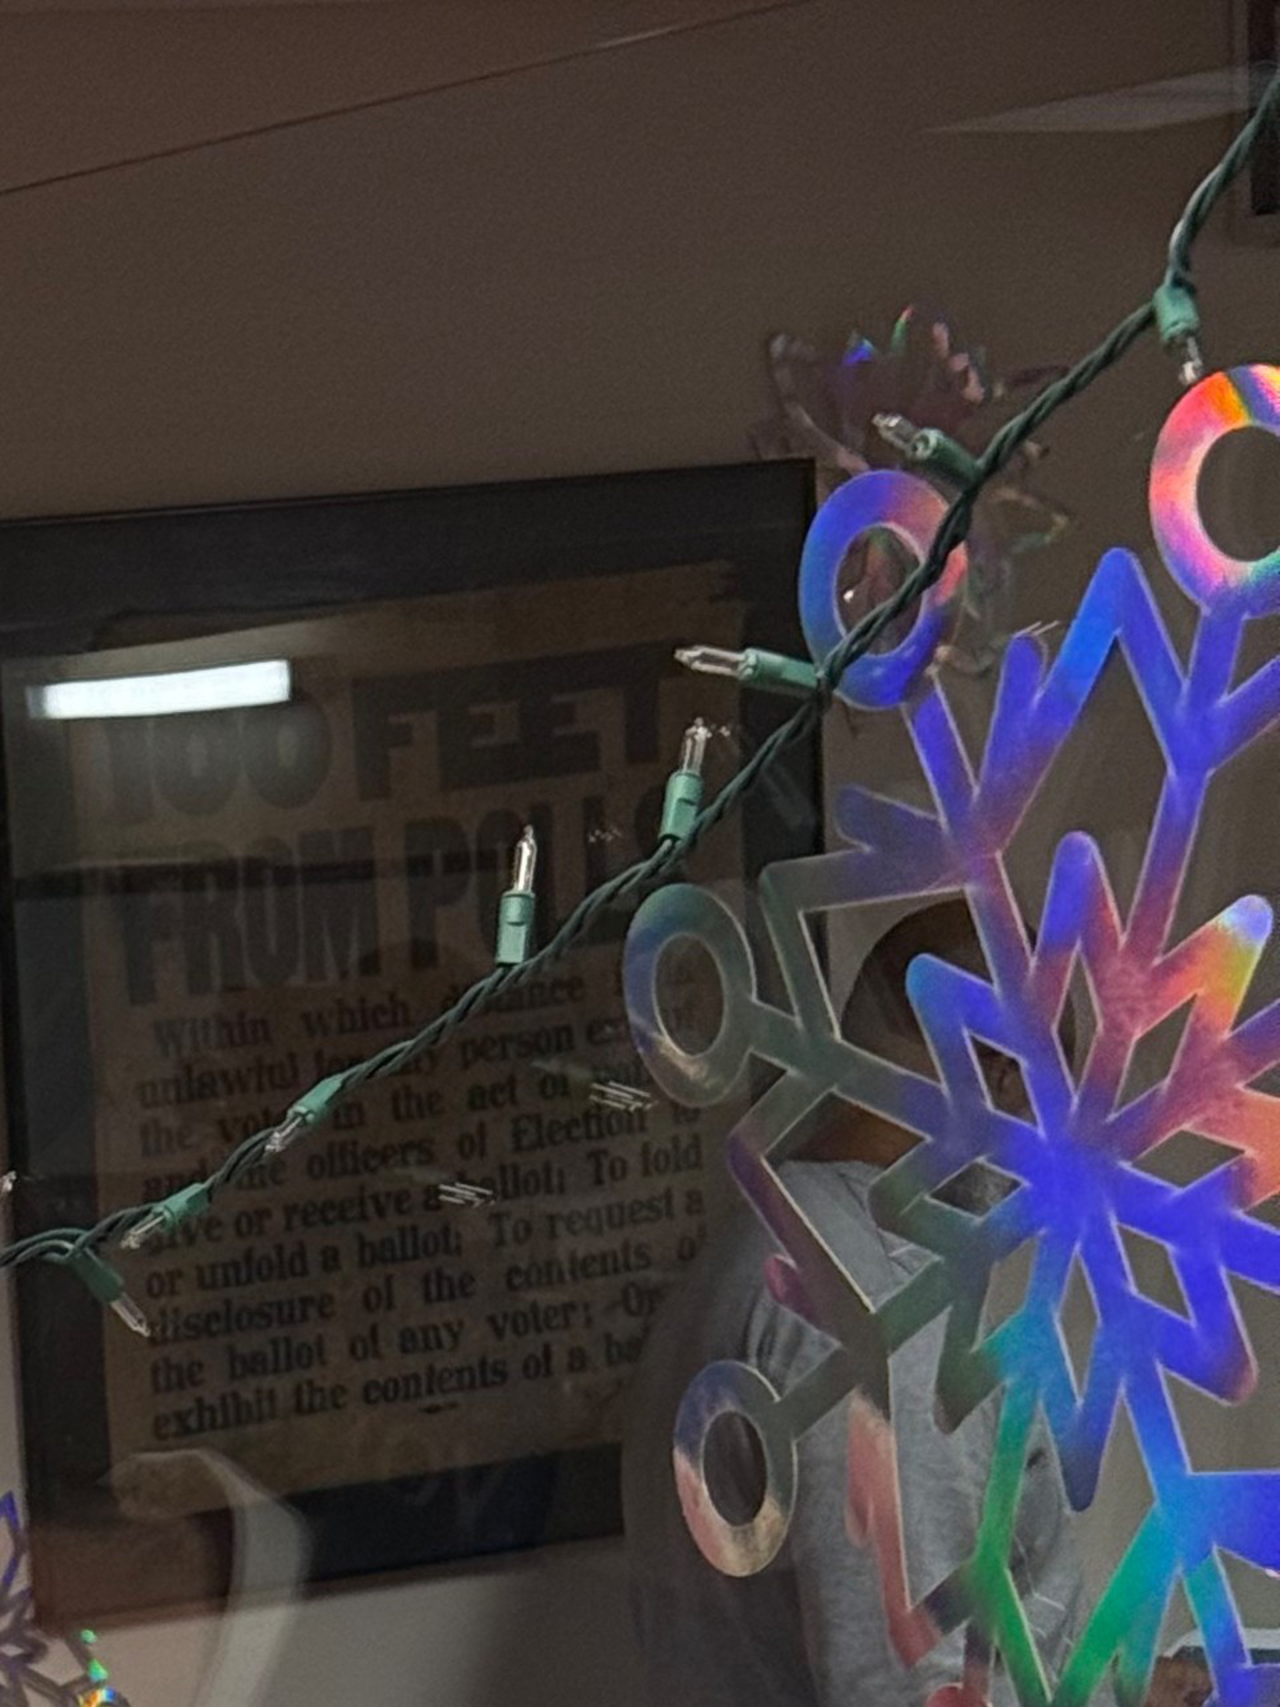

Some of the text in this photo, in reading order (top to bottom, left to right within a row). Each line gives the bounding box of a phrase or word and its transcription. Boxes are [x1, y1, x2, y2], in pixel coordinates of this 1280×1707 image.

[351, 642, 662, 802] FEET
[104, 827, 382, 1006] FROM
[137, 1052, 298, 1106] unlawful
[460, 1024, 574, 1069] person
[153, 1008, 272, 1057] Within
[301, 992, 411, 1037] which
[139, 1116, 192, 1156] the
[391, 1084, 444, 1121] the
[466, 1073, 518, 1110] act
[306, 1136, 435, 1180] officers
[456, 1119, 488, 1160] of
[510, 1106, 647, 1151] Election
[235, 1208, 273, 1238] or
[284, 1186, 411, 1231] receive
[587, 1150, 628, 1186] To
[641, 1131, 703, 1178] fold
[145, 1268, 184, 1299] or
[194, 1239, 310, 1291] unfold
[320, 1243, 341, 1273] a
[487, 1209, 533, 1248] To
[547, 1188, 674, 1239] request
[683, 1188, 704, 1216] a
[147, 1292, 337, 1347] disclosure
[361, 1273, 397, 1314] of
[422, 1266, 475, 1303] the
[504, 1239, 652, 1291] contents
[150, 1354, 204, 1394] the
[226, 1334, 328, 1381] ballot
[349, 1323, 383, 1362] of
[398, 1316, 465, 1356] any
[151, 1385, 280, 1441] exhibit
[292, 1377, 348, 1417] the
[362, 1355, 509, 1406] contents
[521, 1342, 553, 1381] of
[566, 1345, 588, 1375] a
